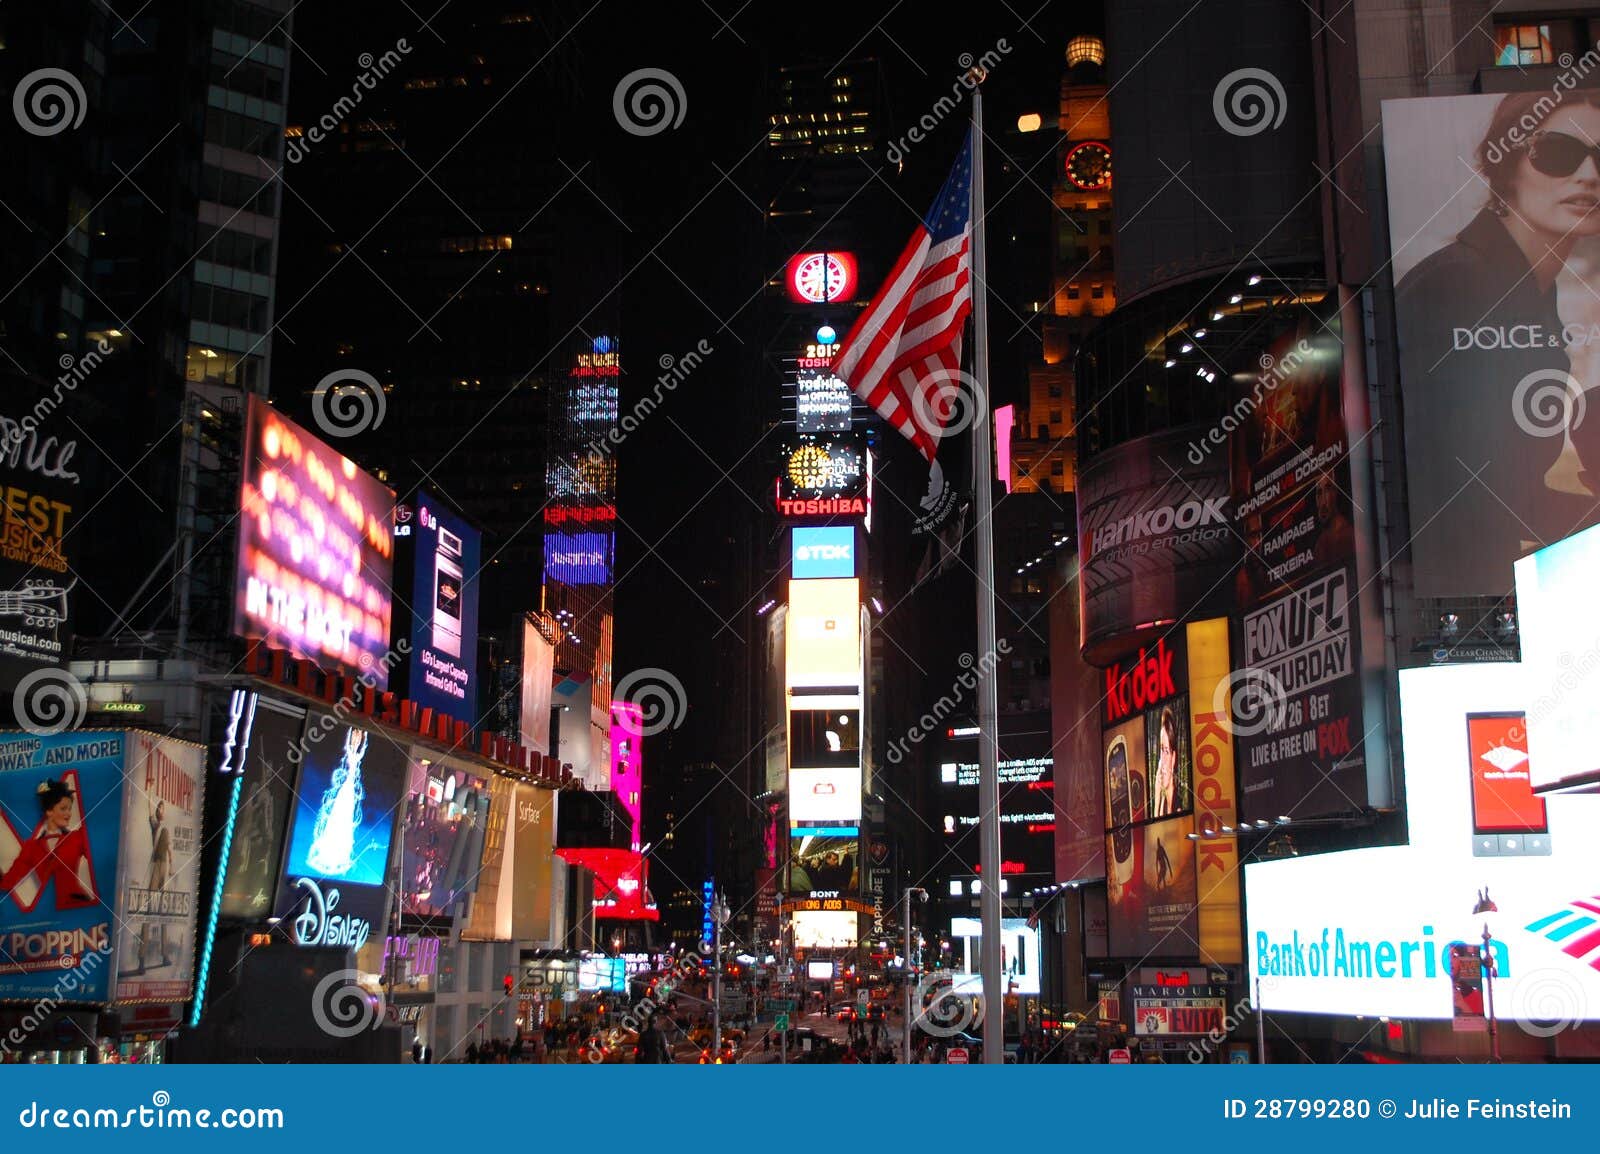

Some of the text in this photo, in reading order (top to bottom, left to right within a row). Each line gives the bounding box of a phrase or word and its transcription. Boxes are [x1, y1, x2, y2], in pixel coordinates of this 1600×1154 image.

[1453, 325, 1544, 350] DOLCE
[1547, 335, 1559, 347] &
[797, 357, 833, 368] TOSH
[1234, 481, 1280, 521] JOHNSON
[1295, 441, 1342, 482] DODSON
[0, 486, 71, 538] EST
[781, 499, 864, 515] TOSHIBA
[394, 525, 410, 536] LG
[428, 514, 437, 531] LG
[1264, 516, 1315, 556] RAMPAGE
[812, 545, 850, 559] TDK
[1106, 526, 1231, 562] driving emotion
[1267, 550, 1314, 582] TEIXEIRA
[1249, 574, 1345, 666] FOX UFC
[1106, 637, 1176, 721] Kodak
[104, 703, 142, 713] LAMAR
[1288, 699, 1303, 728] 26
[46, 747, 74, 766] AND
[76, 739, 120, 761] MORE!
[1251, 716, 1350, 768] LIVE & FREE ON FOX
[1194, 711, 1233, 873] Kodak
[519, 800, 540, 825] Surface
[128, 888, 190, 916] NEWSIES
[810, 890, 839, 898] SONY
[11, 922, 109, 958] POPPINS
[1256, 927, 1306, 976] Bank
[1308, 927, 1329, 977] of
[1172, 1009, 1223, 1034] EVITA
